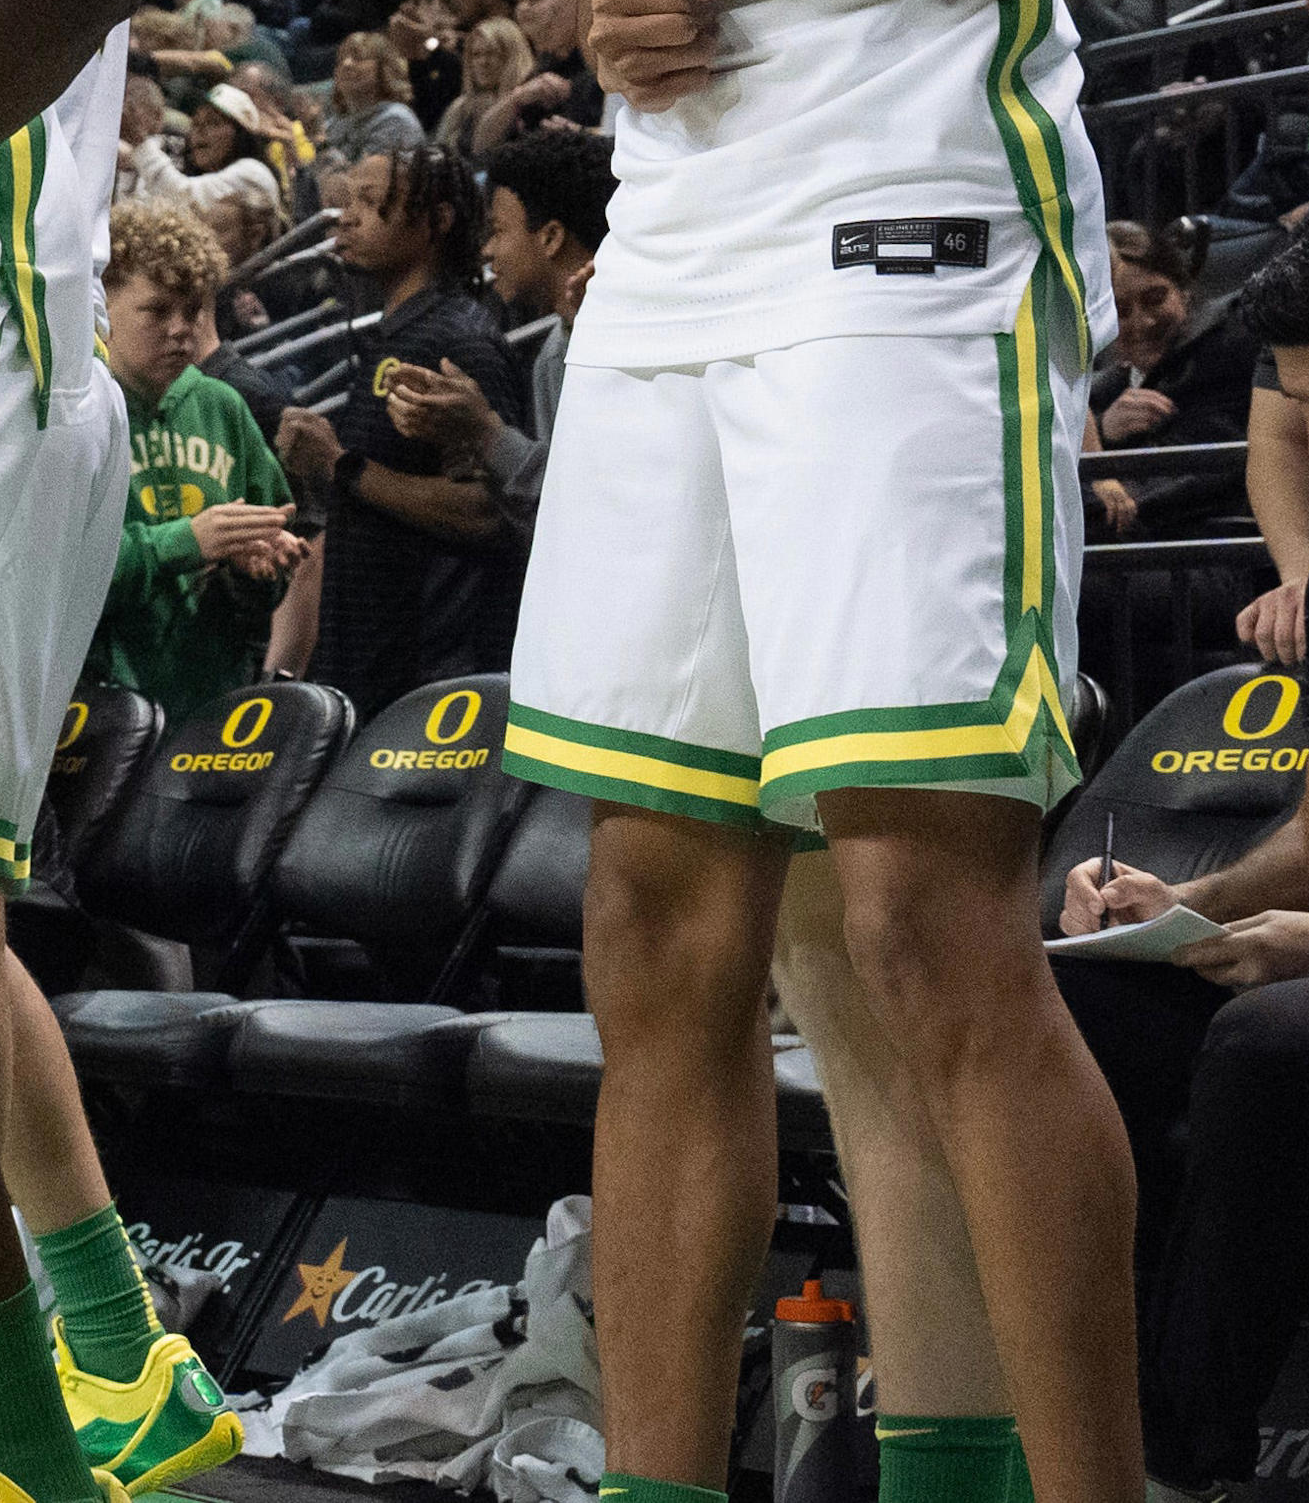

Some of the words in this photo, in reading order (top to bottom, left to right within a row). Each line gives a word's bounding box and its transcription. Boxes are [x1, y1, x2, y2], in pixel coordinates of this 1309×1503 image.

[943, 232, 967, 252] 46
[221, 697, 274, 749] O
[425, 689, 483, 746] O
[1222, 674, 1302, 741] O
